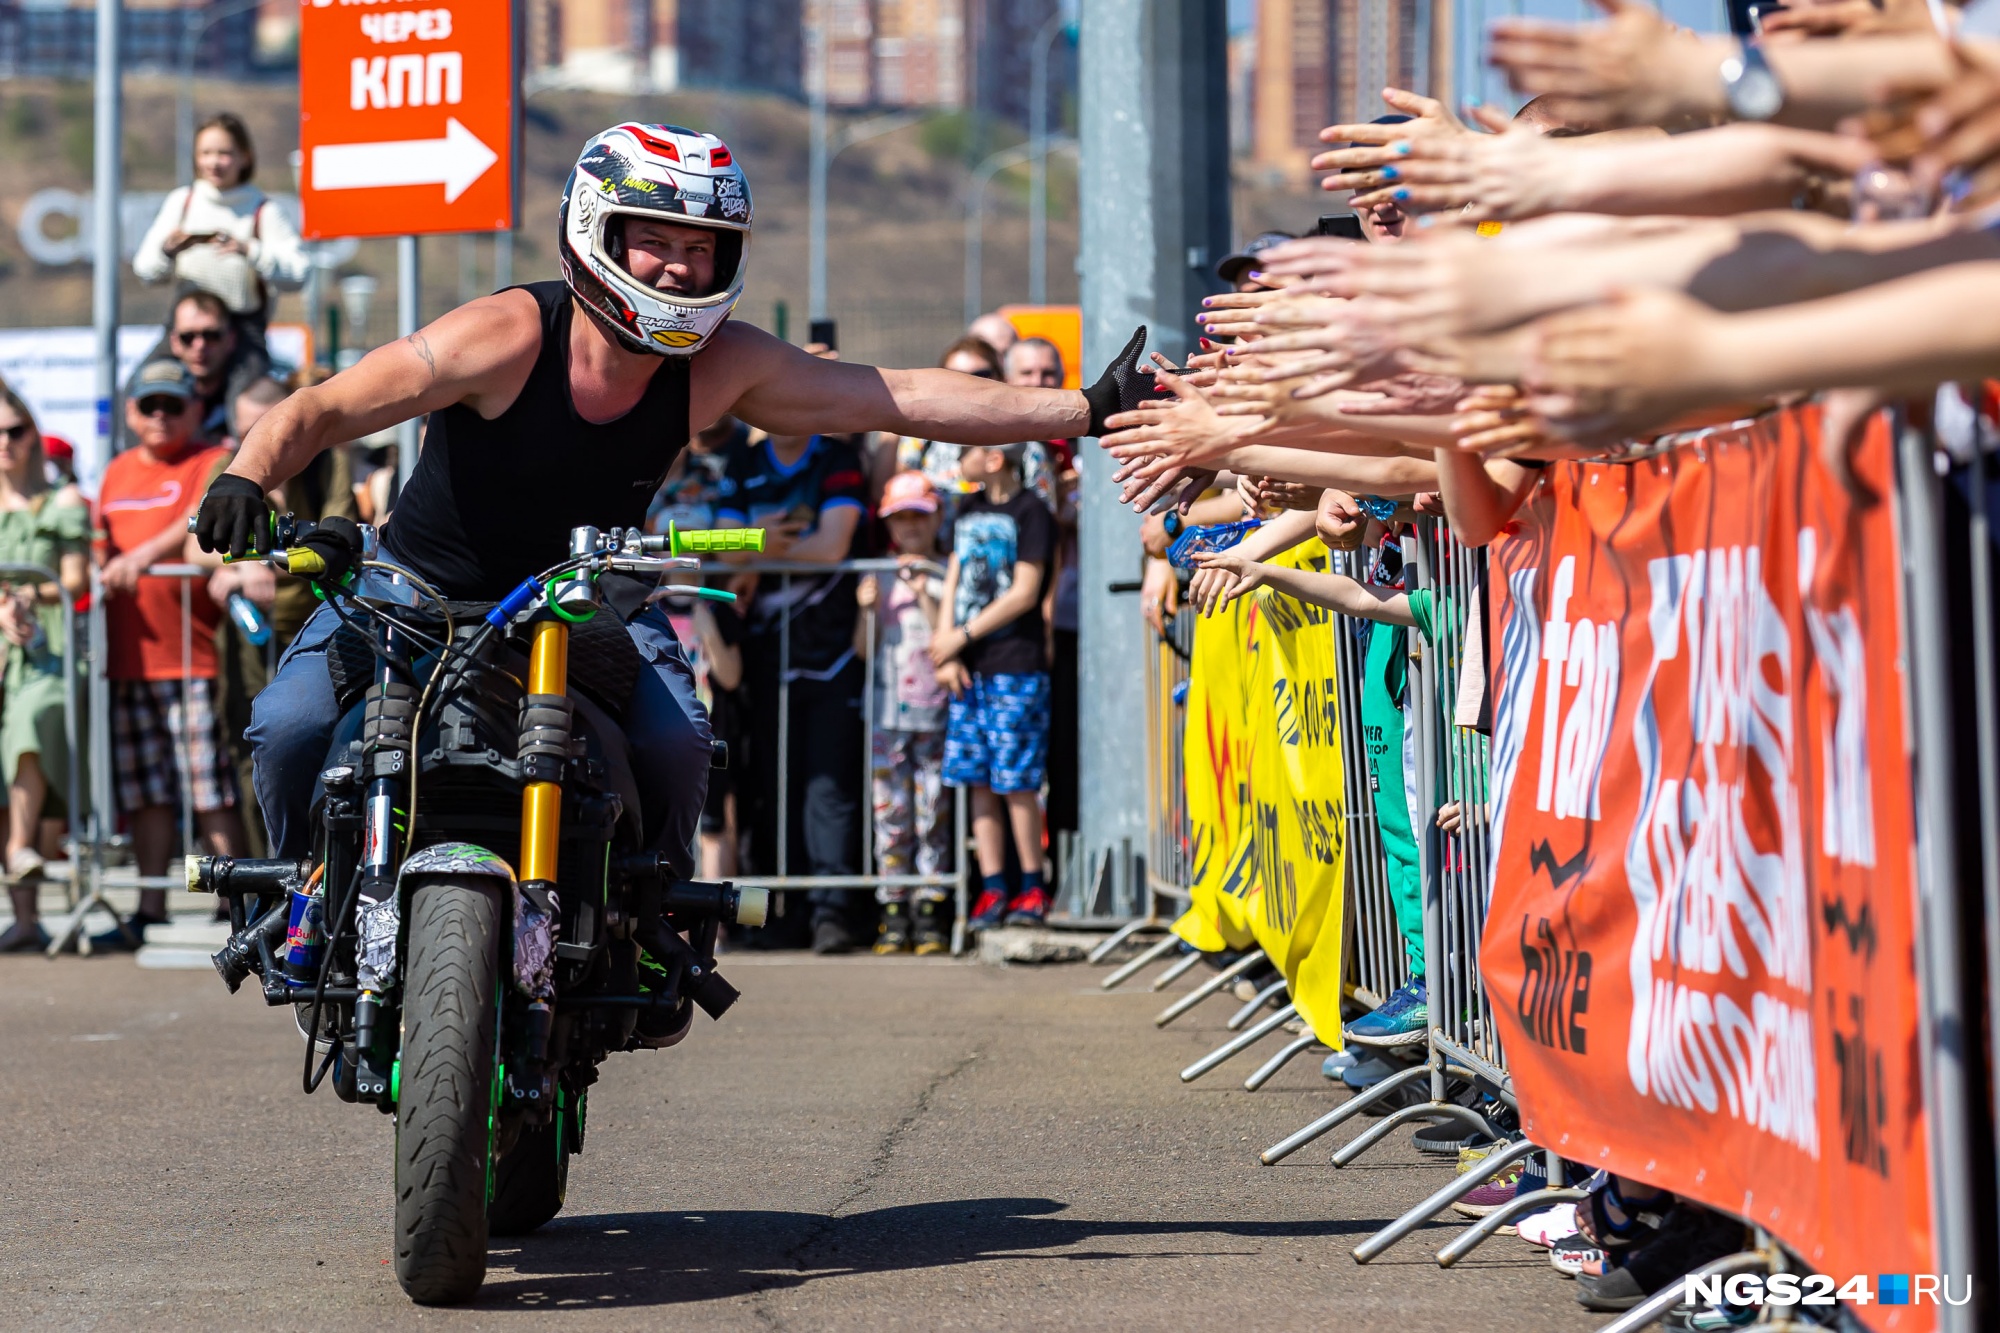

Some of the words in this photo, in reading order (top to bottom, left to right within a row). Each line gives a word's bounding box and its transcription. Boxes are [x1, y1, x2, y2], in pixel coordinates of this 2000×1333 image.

[361, 8, 453, 43] ЧЕРЕЗ
[351, 51, 463, 110] КПП
[635, 315, 696, 331] SHIMA
[1536, 555, 1620, 822] fan
[1518, 912, 1593, 1056] bike
